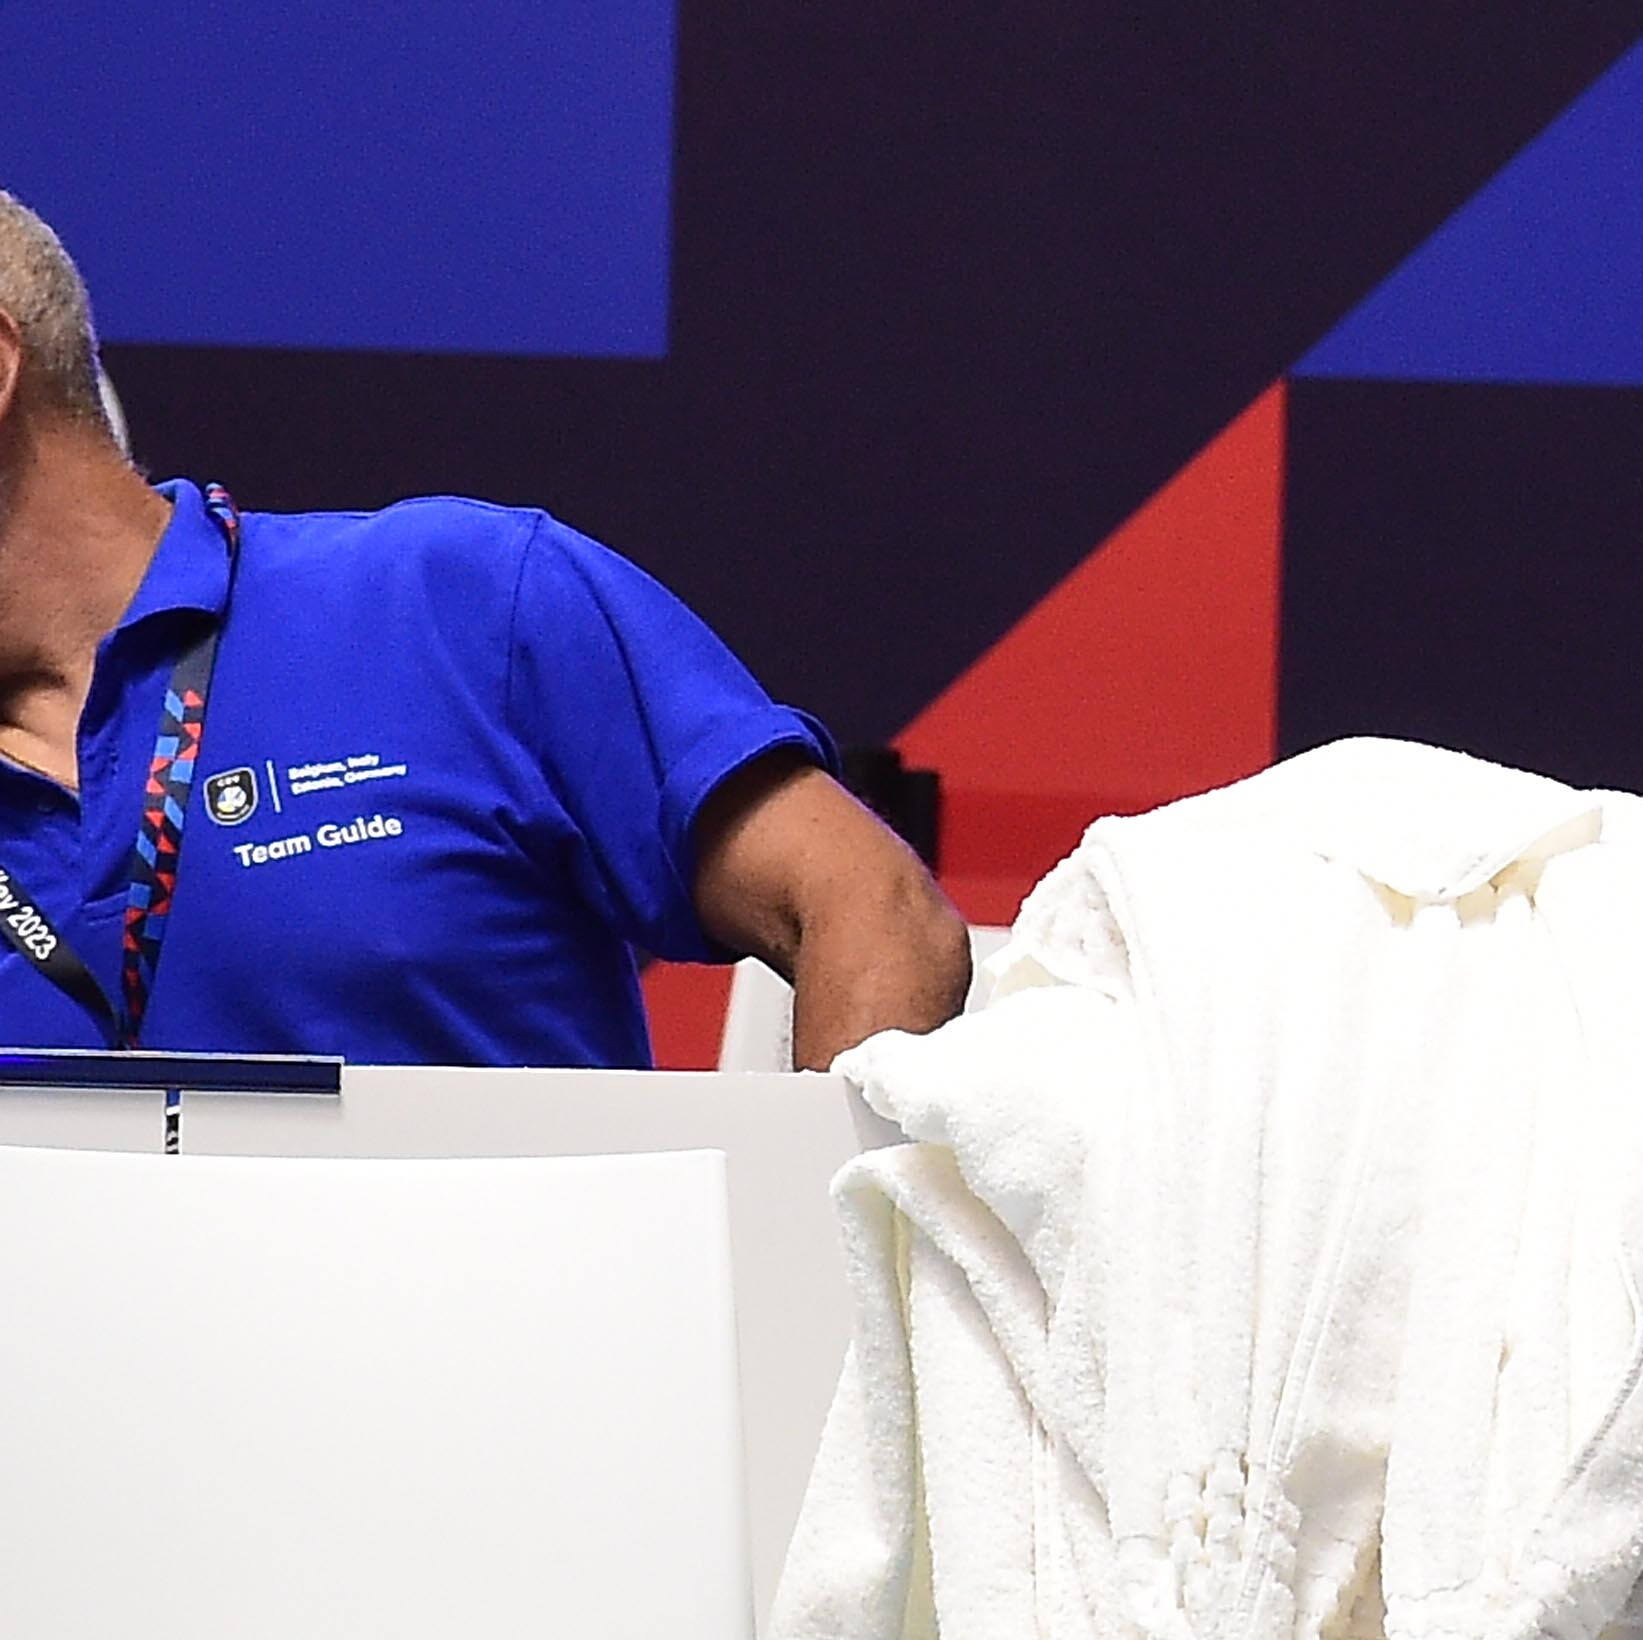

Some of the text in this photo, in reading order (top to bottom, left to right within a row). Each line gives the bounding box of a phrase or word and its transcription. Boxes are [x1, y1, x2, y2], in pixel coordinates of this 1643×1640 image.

[233, 813, 404, 868] Team Guide
[7, 905, 57, 961] 2023
